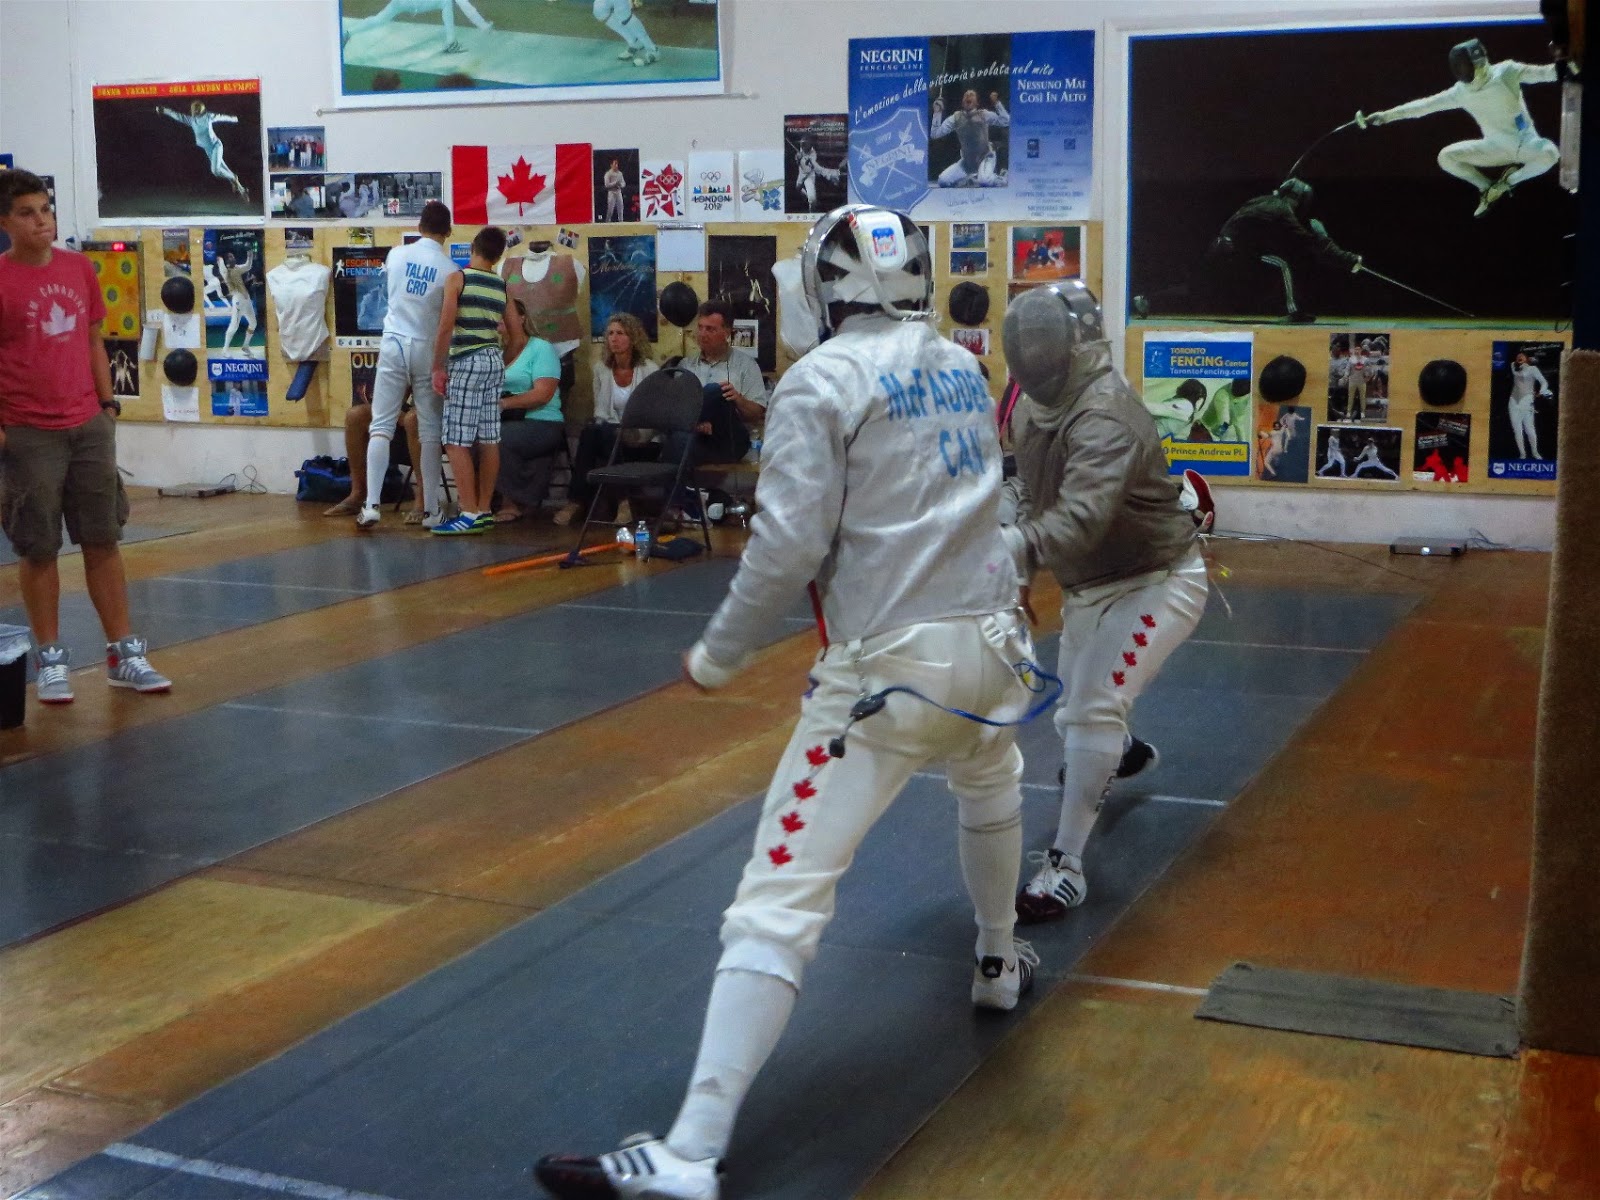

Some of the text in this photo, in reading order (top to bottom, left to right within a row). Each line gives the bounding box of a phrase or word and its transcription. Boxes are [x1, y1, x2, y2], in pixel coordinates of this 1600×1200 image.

[860, 48, 924, 64] NEGRINI
[1017, 78, 1087, 91] NESSUNO MAI
[855, 93, 900, 125] L'emozione
[902, 77, 928, 99] della
[929, 69, 968, 88] vittoria
[1012, 59, 1033, 75] nel
[1031, 63, 1054, 76] mito
[1046, 92, 1058, 103] IN
[1060, 91, 1087, 103] ALTO
[693, 194, 732, 203] LONDON
[703, 202, 722, 211] 2012
[405, 262, 438, 283] TALAN
[406, 279, 429, 297] CRO
[1170, 347, 1206, 355] TORONTO
[351, 353, 378, 369] OU
[1170, 356, 1224, 367] FENCING
[225, 362, 263, 373] NEGRINI
[1170, 367, 1248, 376] TorontoFencing.com
[1171, 447, 1197, 455] Prince
[1199, 447, 1232, 456] Andrew
[1508, 462, 1554, 472] NEGRINI
